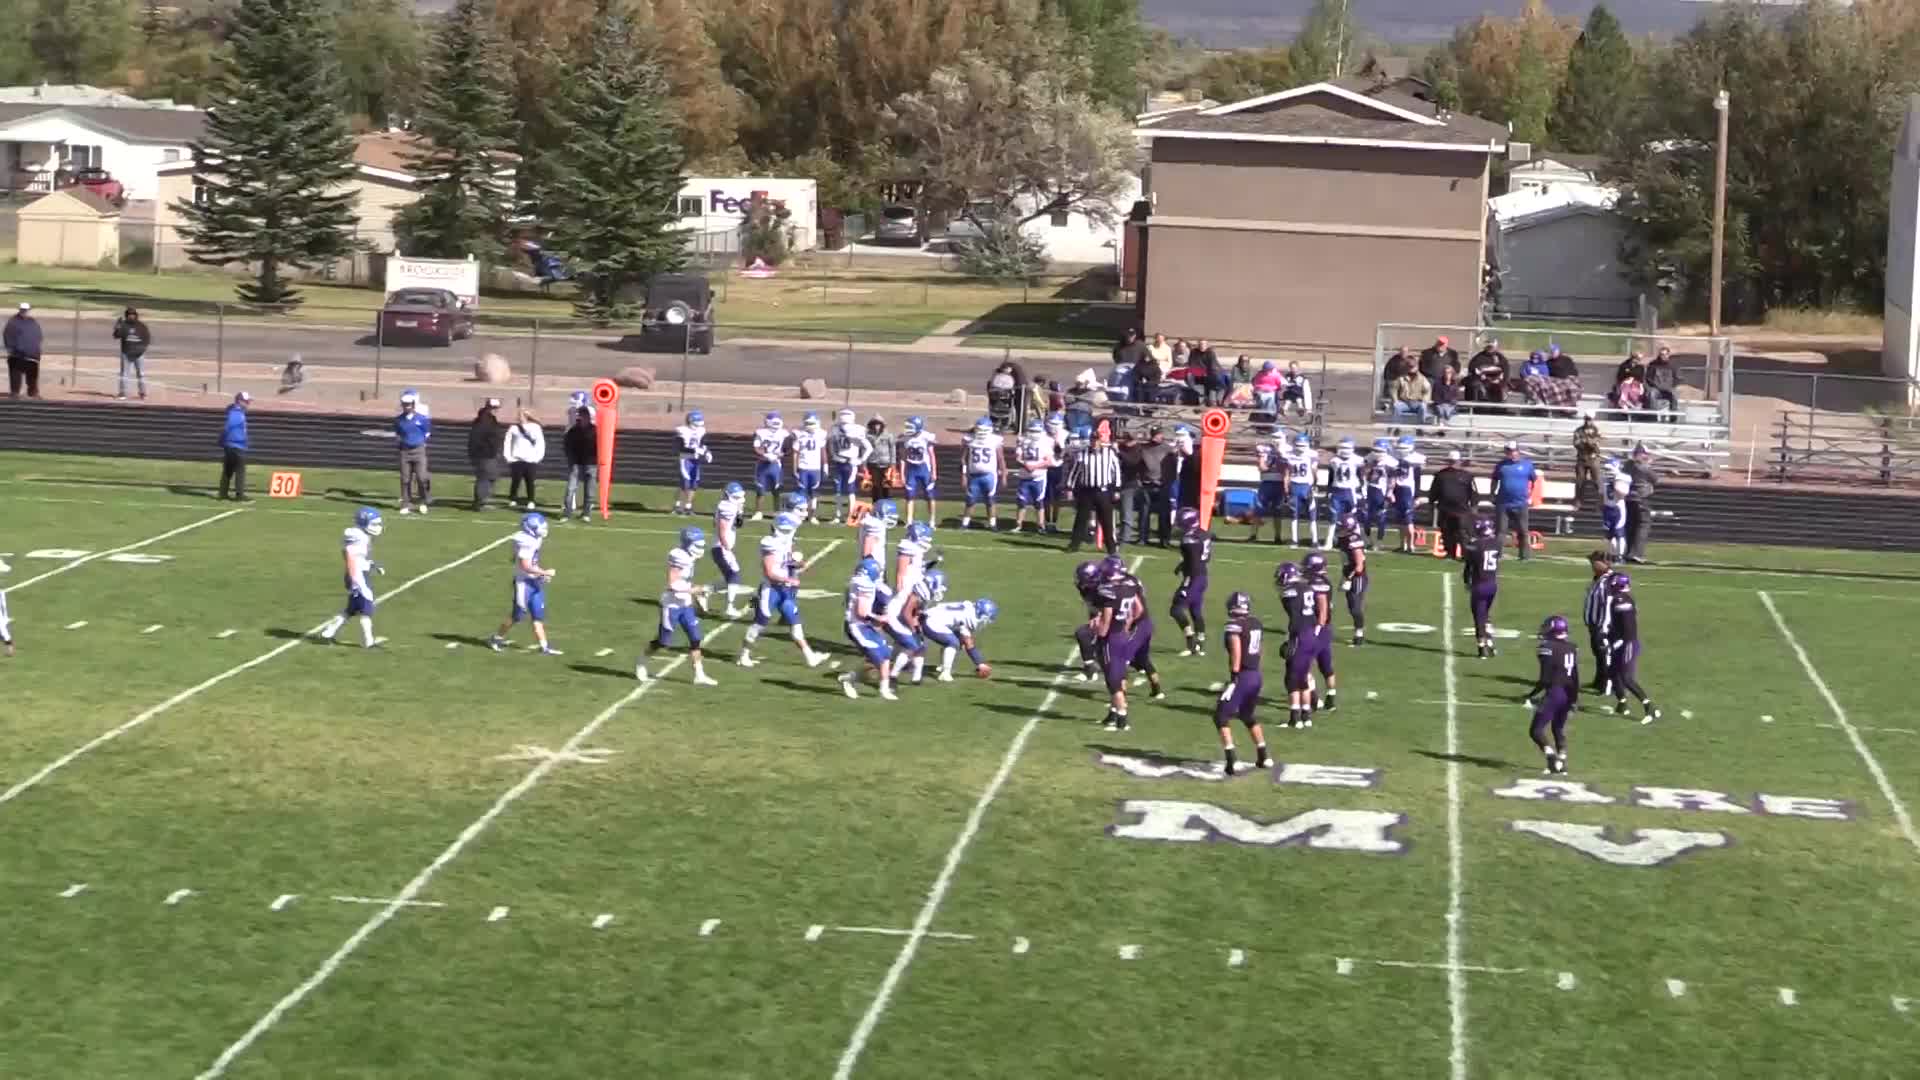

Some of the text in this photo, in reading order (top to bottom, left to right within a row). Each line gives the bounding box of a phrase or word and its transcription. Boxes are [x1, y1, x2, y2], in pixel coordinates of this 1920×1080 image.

[272, 475, 295, 495] 30
[1483, 550, 1499, 571] 15
[1564, 653, 1575, 677] 4
[1098, 752, 1850, 820] WE ARE
